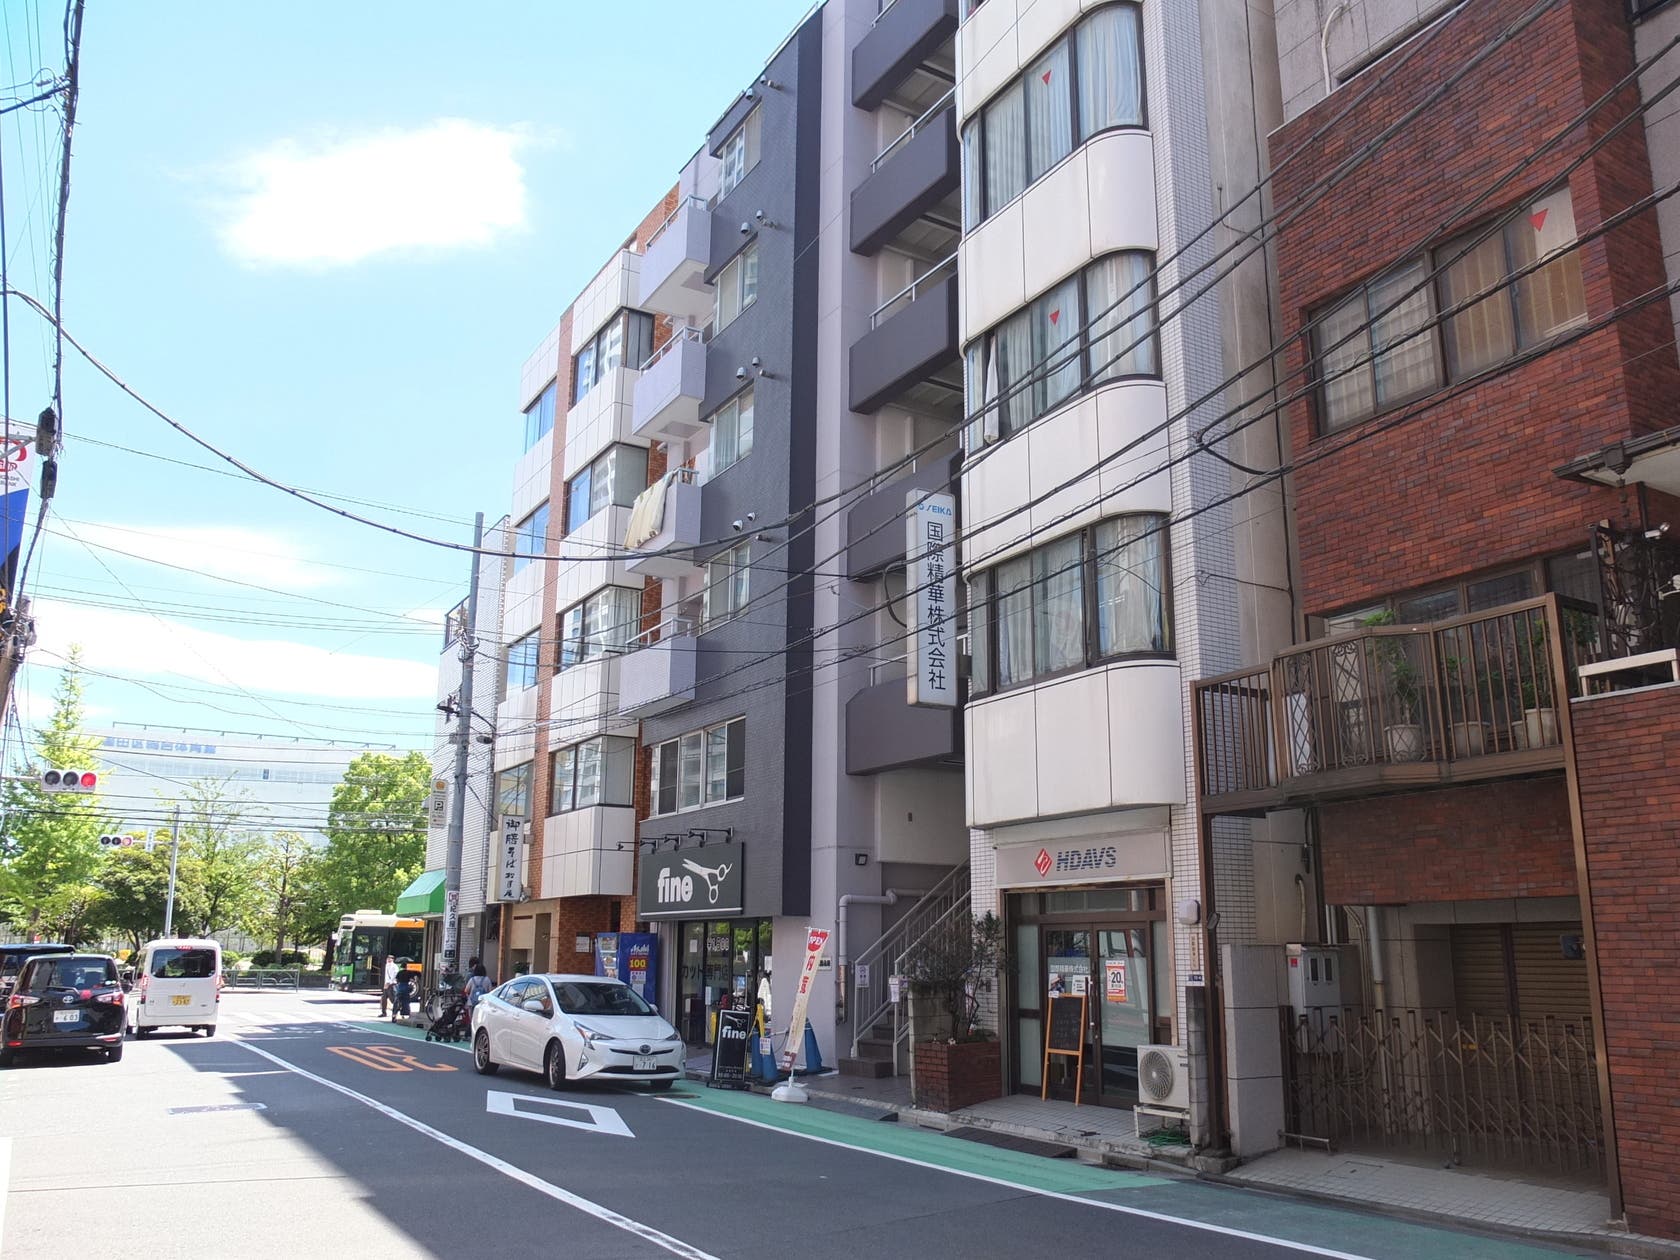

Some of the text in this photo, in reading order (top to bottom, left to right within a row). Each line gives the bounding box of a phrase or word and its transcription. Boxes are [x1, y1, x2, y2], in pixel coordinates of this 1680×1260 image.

[926, 521, 946, 690] 国際精華株式会社
[1056, 847, 1116, 871] HDAVS
[657, 867, 693, 903] fine
[630, 959, 646, 968] 100
[722, 1025, 747, 1040] fine
